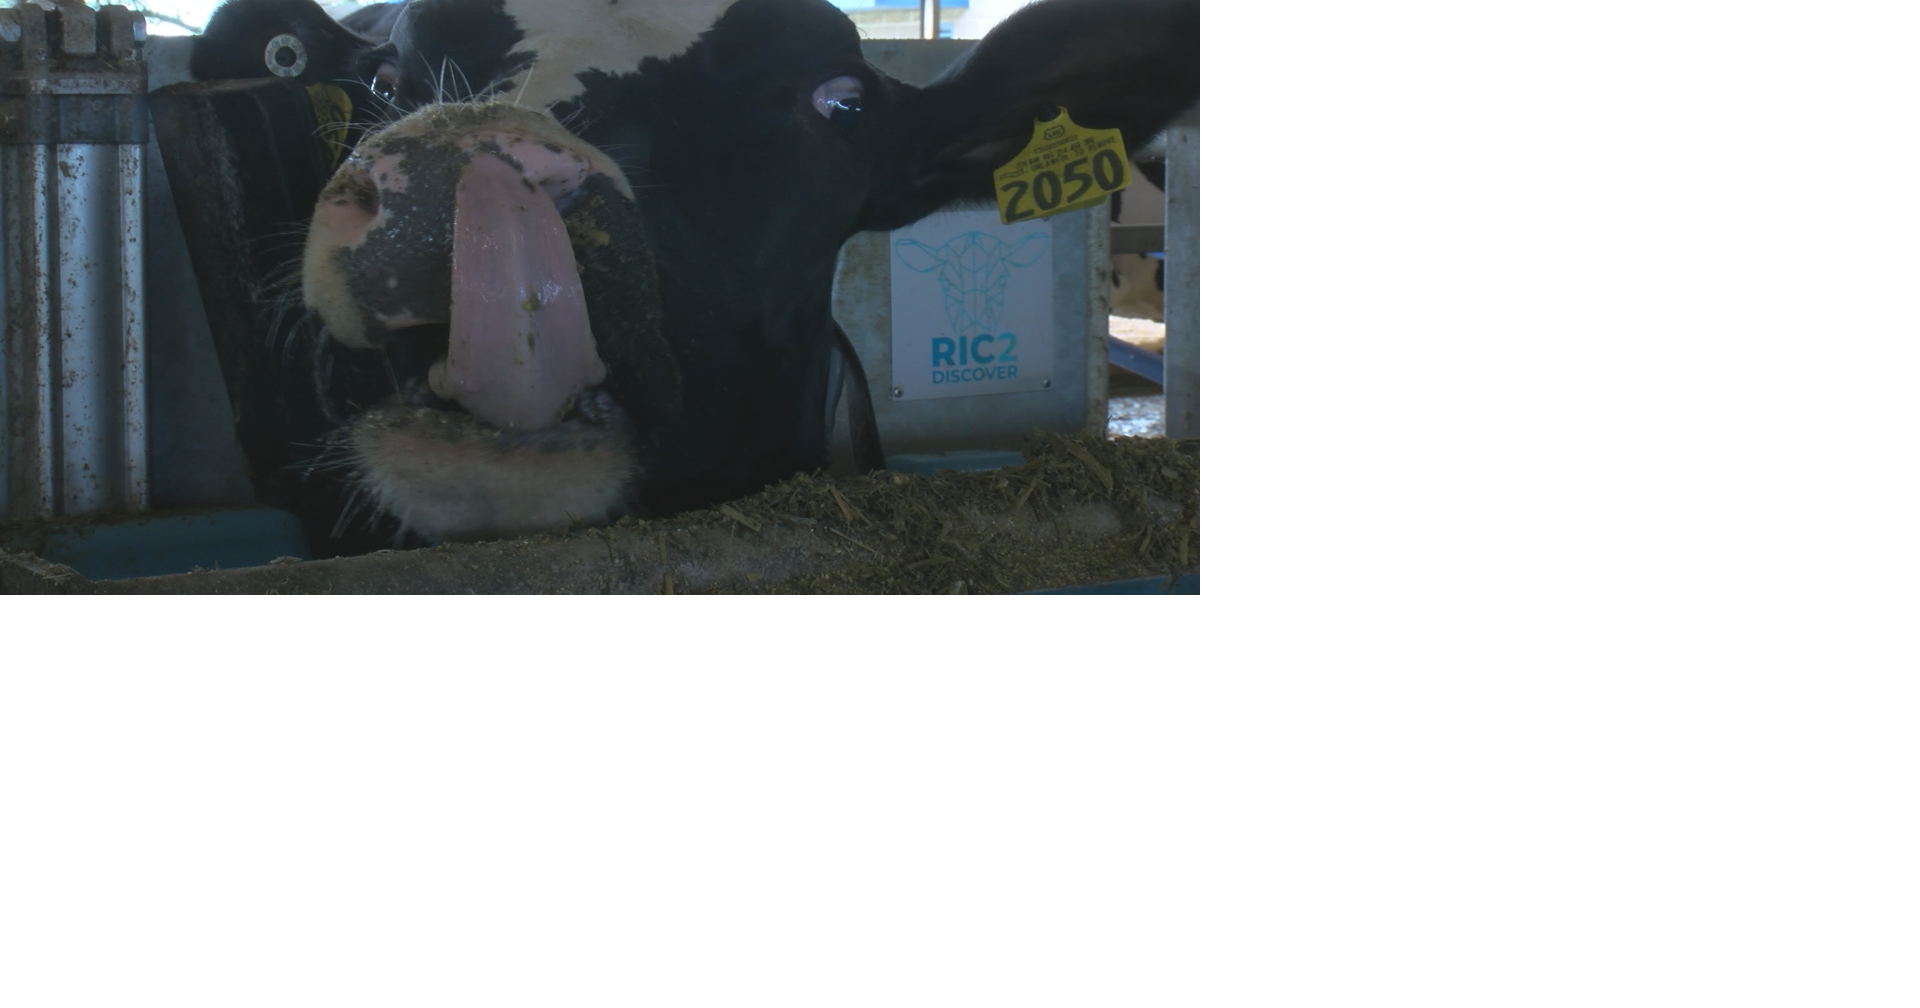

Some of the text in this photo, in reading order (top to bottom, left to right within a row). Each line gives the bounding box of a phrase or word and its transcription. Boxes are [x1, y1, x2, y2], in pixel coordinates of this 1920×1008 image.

[1087, 136, 1117, 151] REMOVE
[1000, 148, 1124, 223] 2050
[932, 332, 1017, 368] RIC2
[932, 365, 1018, 384] DISCOVER
